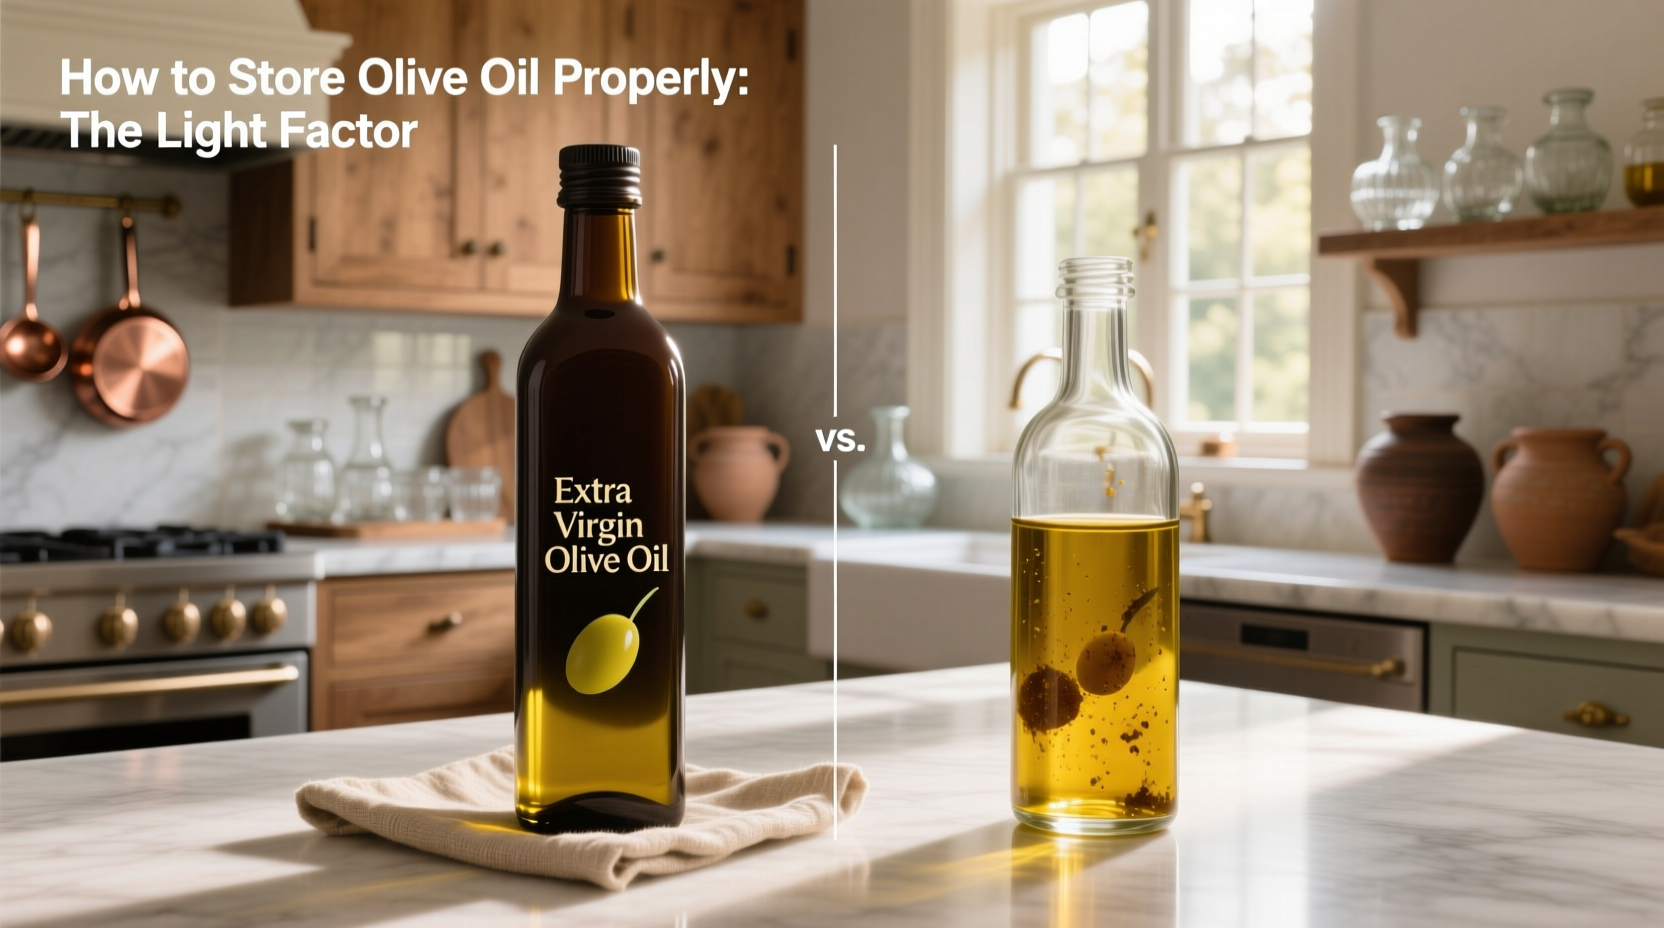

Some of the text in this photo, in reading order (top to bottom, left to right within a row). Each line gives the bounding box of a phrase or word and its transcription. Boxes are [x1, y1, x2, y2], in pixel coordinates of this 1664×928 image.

[554, 476, 632, 504] Extra
[553, 510, 644, 546] Virgin
[544, 543, 669, 574] Olive Oil
